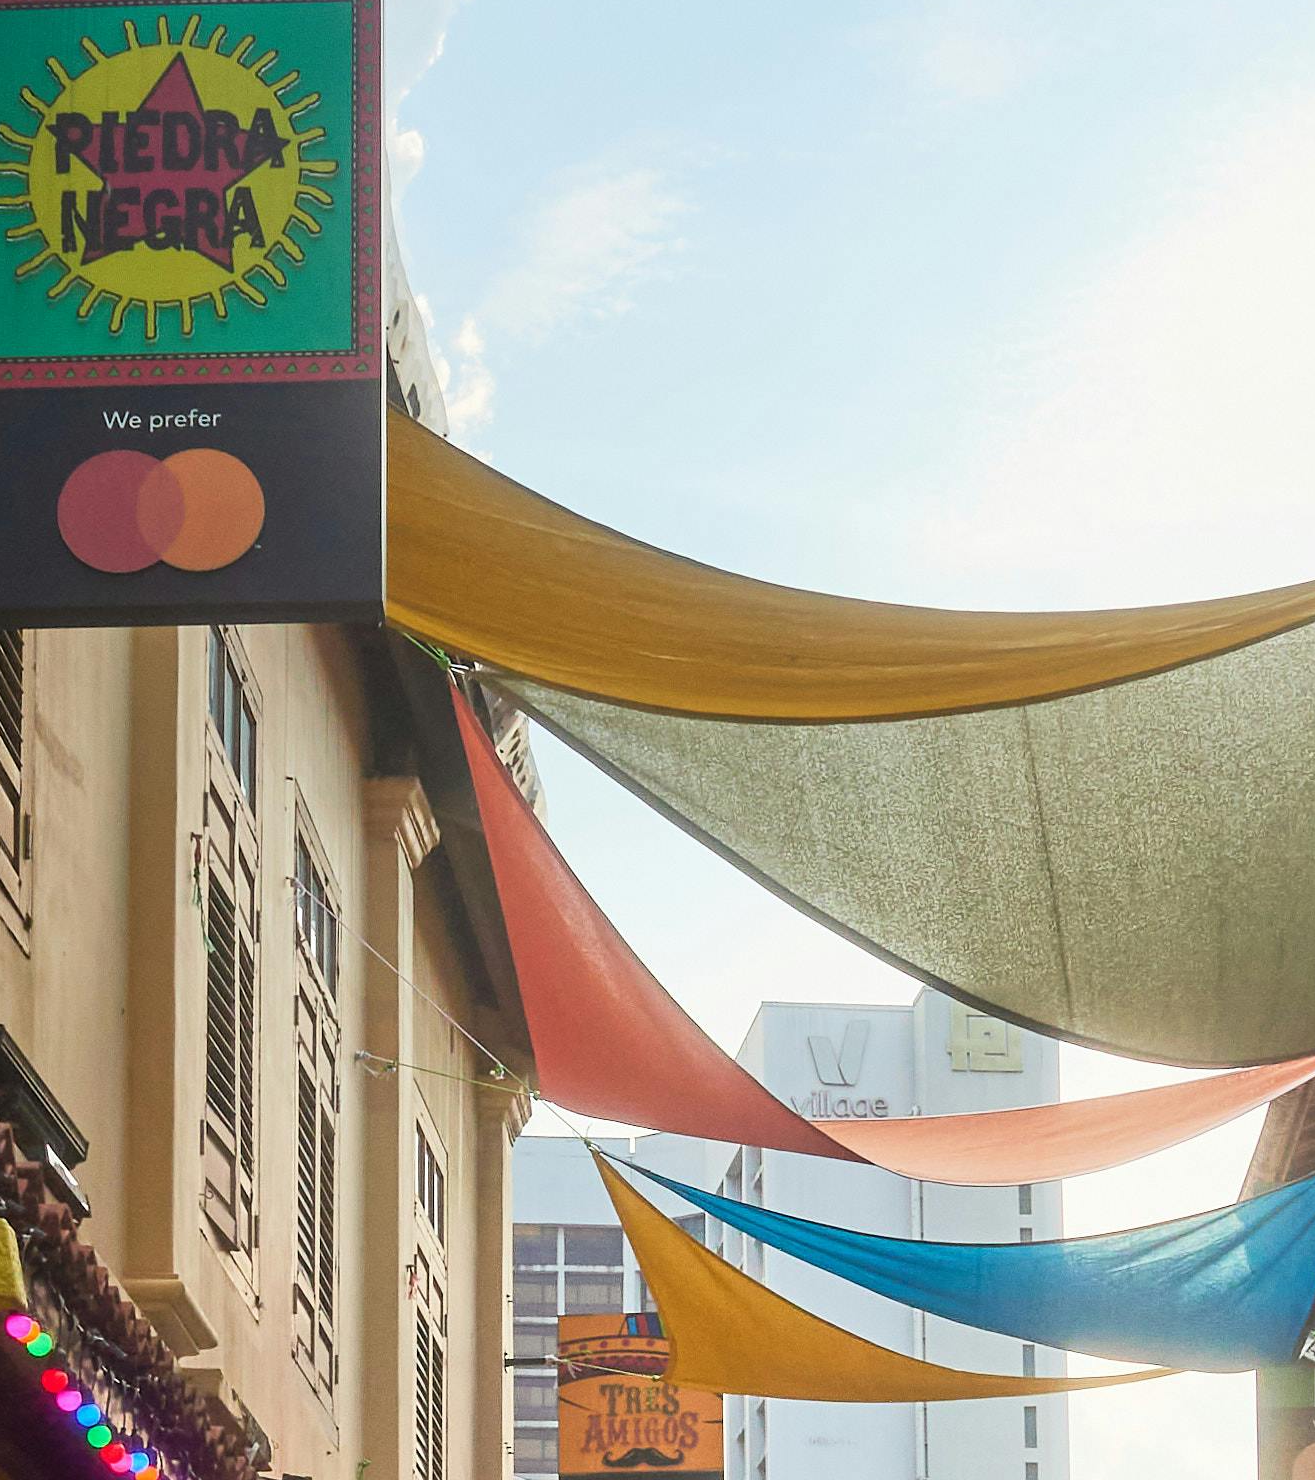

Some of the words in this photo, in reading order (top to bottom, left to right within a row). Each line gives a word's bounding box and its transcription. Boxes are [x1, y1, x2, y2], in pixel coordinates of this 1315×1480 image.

[60, 188, 265, 252] NEGRA
[102, 411, 143, 430] We
[149, 409, 222, 433] prefer
[599, 1383, 680, 1416] TRES
[580, 1412, 700, 1453] AMIGOS
